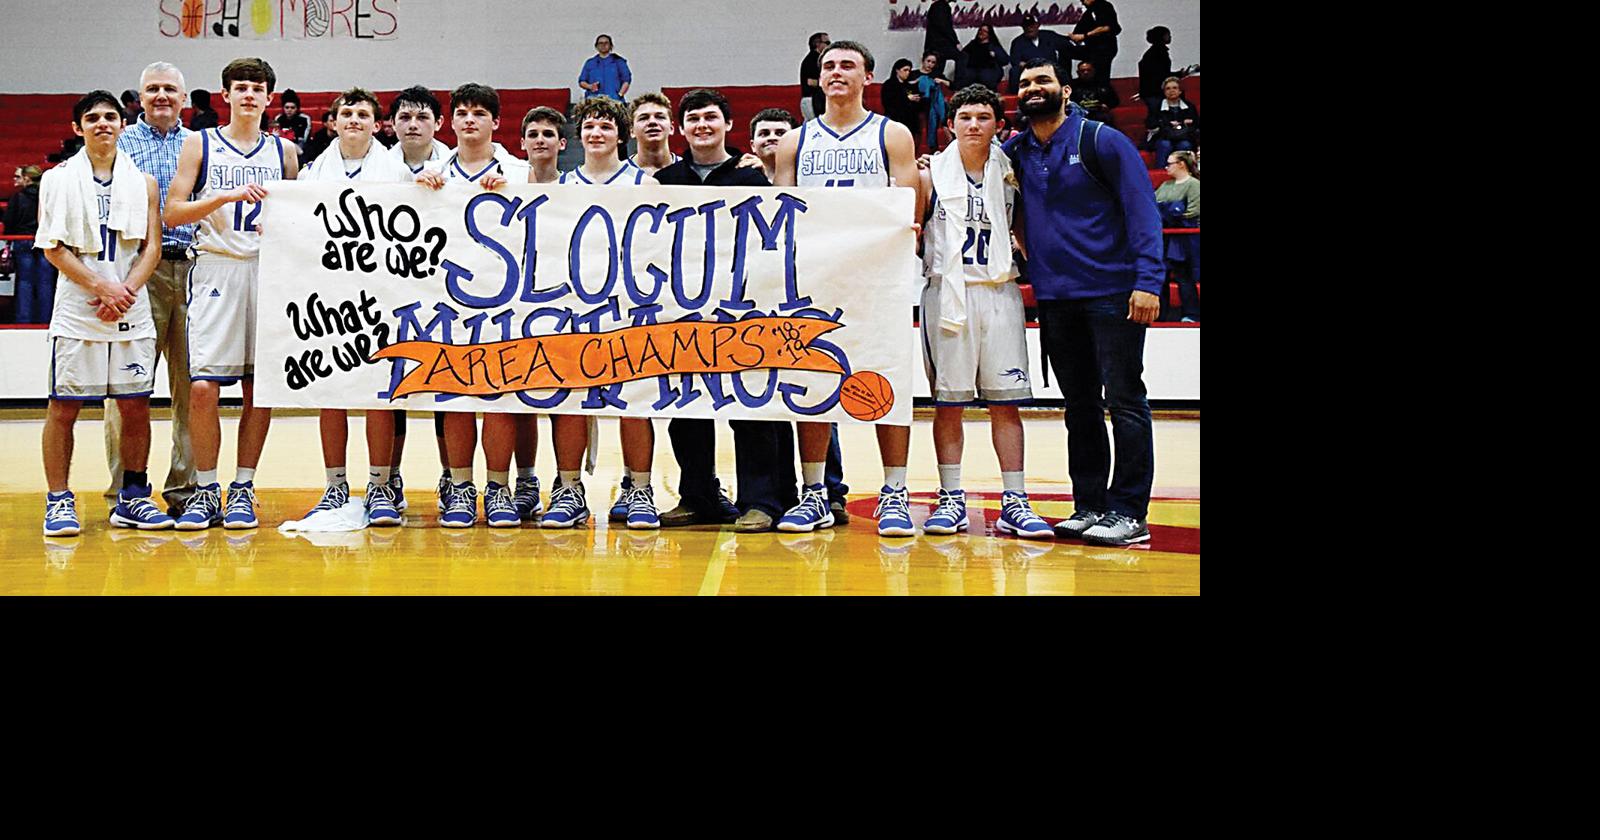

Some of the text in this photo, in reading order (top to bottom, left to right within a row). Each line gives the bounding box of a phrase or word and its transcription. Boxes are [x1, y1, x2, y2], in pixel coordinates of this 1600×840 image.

[210, 165, 280, 190] SLOCUM
[802, 148, 879, 176] SLOCUM
[234, 200, 262, 231] 12
[314, 188, 421, 243] Who
[321, 226, 448, 279] are we?
[441, 192, 812, 308] SLOCUM
[961, 227, 992, 266] 20
[286, 289, 382, 342] What
[284, 322, 391, 391] are we?
[424, 325, 766, 391] AREA CHAMPS
